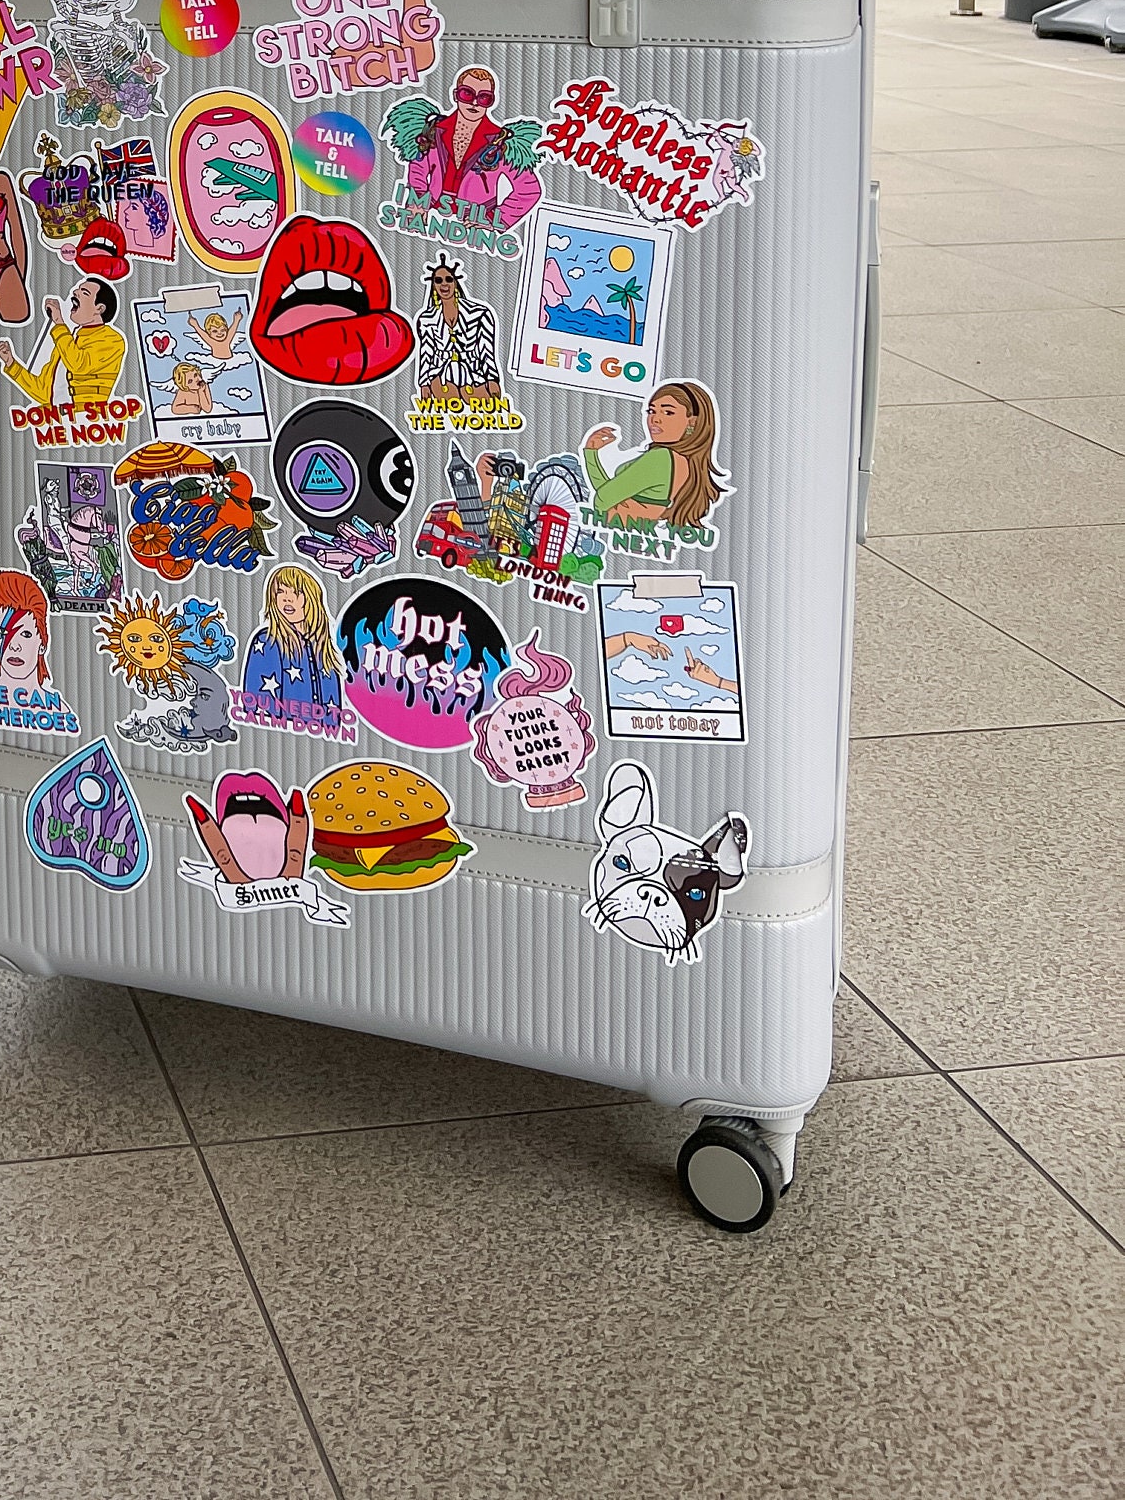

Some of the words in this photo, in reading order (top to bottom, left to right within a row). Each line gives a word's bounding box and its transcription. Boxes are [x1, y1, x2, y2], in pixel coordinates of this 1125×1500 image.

[194, 13, 205, 25] &
[184, 23, 218, 41] TELL
[256, 5, 441, 64] STRONG
[289, 46, 419, 99] BITCH
[315, 127, 355, 148] TALK
[554, 80, 713, 180] Hopeless
[327, 148, 339, 160] &
[42, 164, 81, 181] GOD
[89, 161, 139, 183] SAVE
[315, 160, 348, 180] TELL
[536, 113, 711, 229] Romantic
[45, 185, 83, 205] THE
[87, 182, 156, 204] QUEEN
[437, 194, 507, 233] STILL
[379, 204, 520, 258] STANDING
[530, 343, 593, 373] LET'S
[600, 356, 647, 383] GO
[85, 397, 143, 422] STOP
[415, 397, 464, 414] WHO
[469, 396, 511, 414] RUN
[181, 423, 203, 440] cry
[206, 420, 242, 438] baby
[407, 413, 447, 431] THE
[448, 413, 524, 431] WORLD
[35, 425, 70, 448] ME
[71, 421, 126, 444] NOW
[310, 476, 333, 485] AGAIN
[314, 468, 327, 476] TRY
[130, 478, 219, 526] Ciao
[579, 506, 656, 537] THANK
[665, 521, 716, 548] YOU
[168, 519, 261, 573] bella
[612, 531, 676, 561] NEXT
[494, 556, 573, 589] LONDON
[63, 600, 105, 612] DEATH
[532, 583, 586, 611] THING
[389, 596, 467, 652] hot
[361, 642, 484, 699] mess
[13, 687, 62, 711] CAN
[229, 688, 271, 710] YOU
[274, 698, 326, 720] NEED
[327, 706, 357, 726] TO
[230, 706, 288, 730] CALM
[292, 716, 356, 743] DOWN
[508, 707, 546, 726] YOUR
[631, 714, 665, 731] not
[668, 714, 721, 737] today
[504, 719, 560, 742] FUTURE
[513, 735, 563, 758] LOOKS
[515, 751, 571, 773] BRIGHT
[47, 816, 89, 843] yes
[97, 835, 127, 859] no
[235, 883, 302, 907] Sinner
